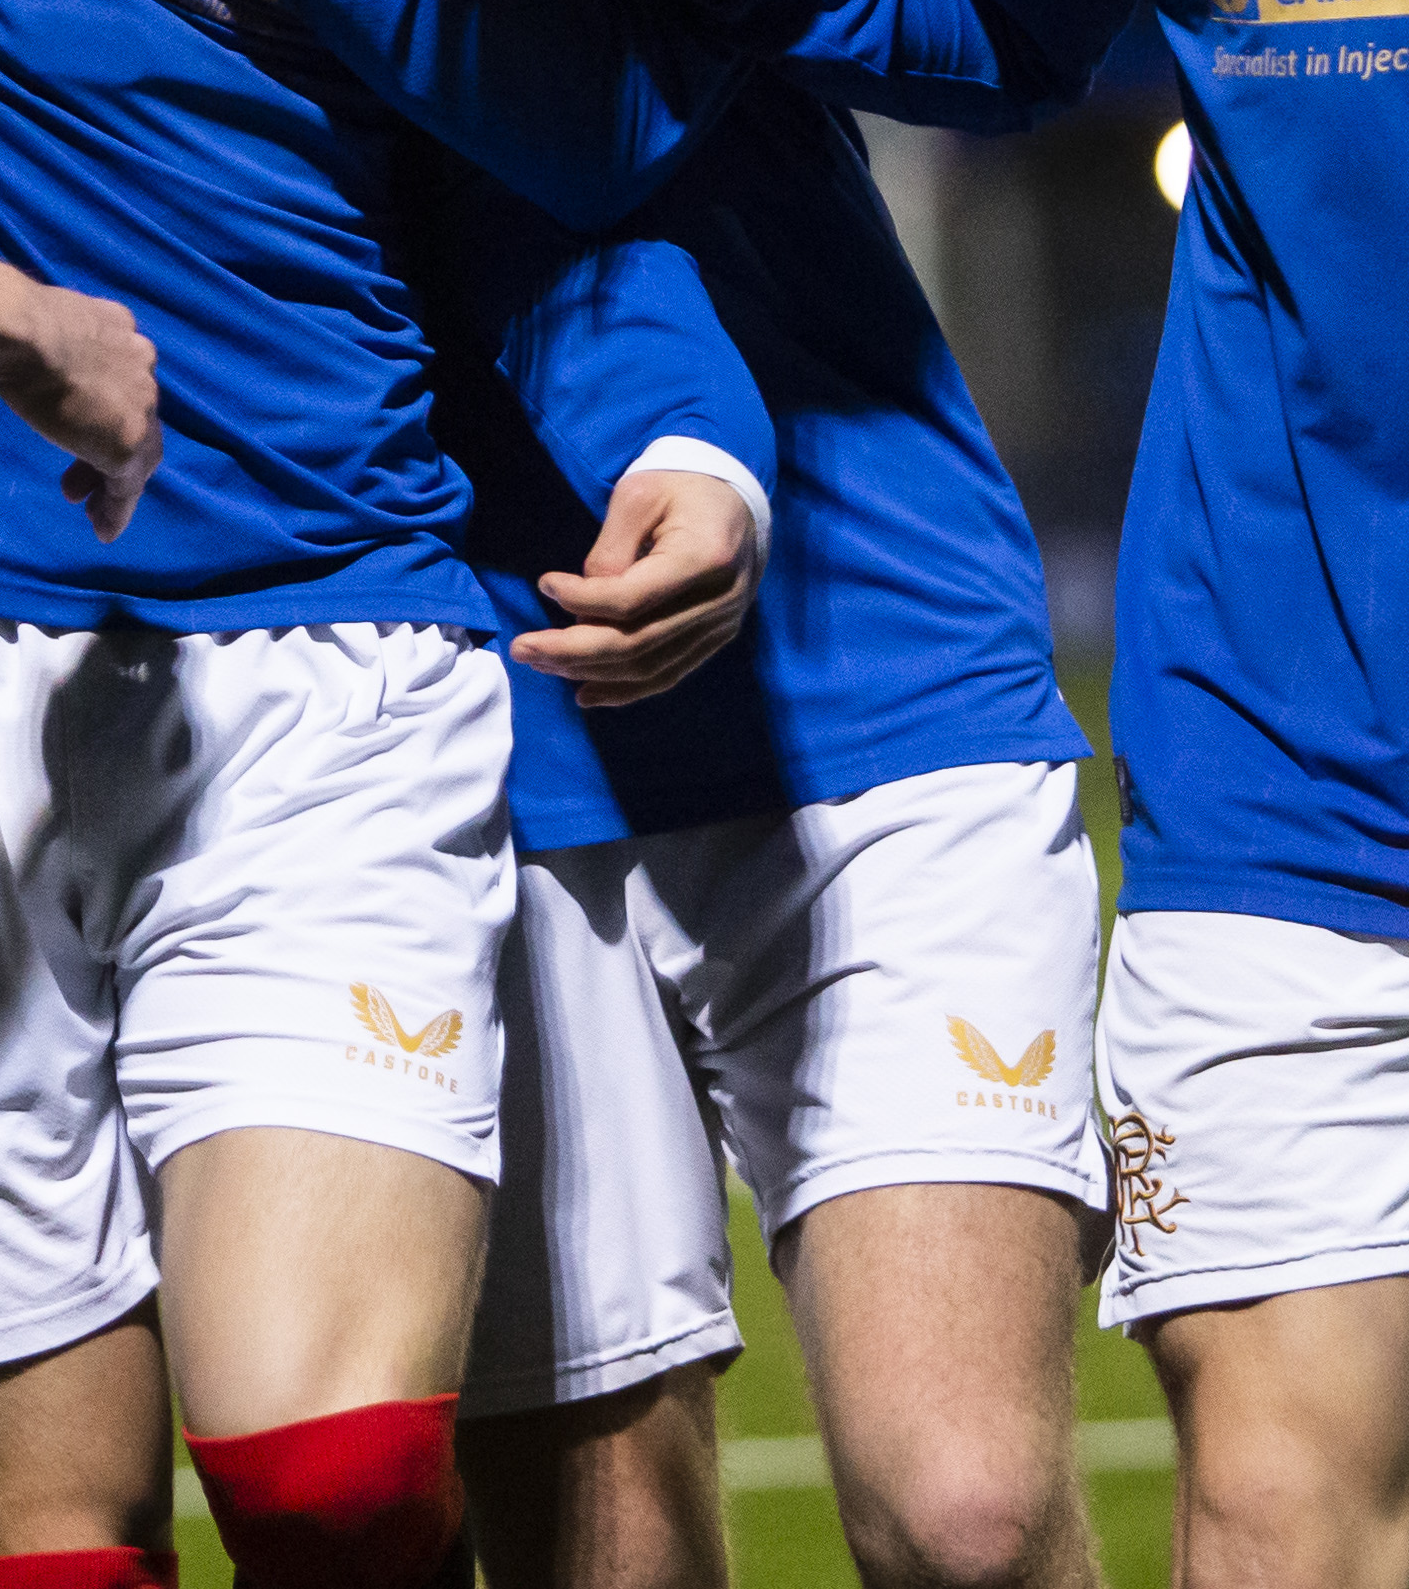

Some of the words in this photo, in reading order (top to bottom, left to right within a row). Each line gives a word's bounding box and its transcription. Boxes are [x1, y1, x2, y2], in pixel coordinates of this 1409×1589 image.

[1305, 46, 1331, 77] in
[345, 1045, 459, 1095] CASTORE
[956, 1090, 1058, 1121] CASTORE
